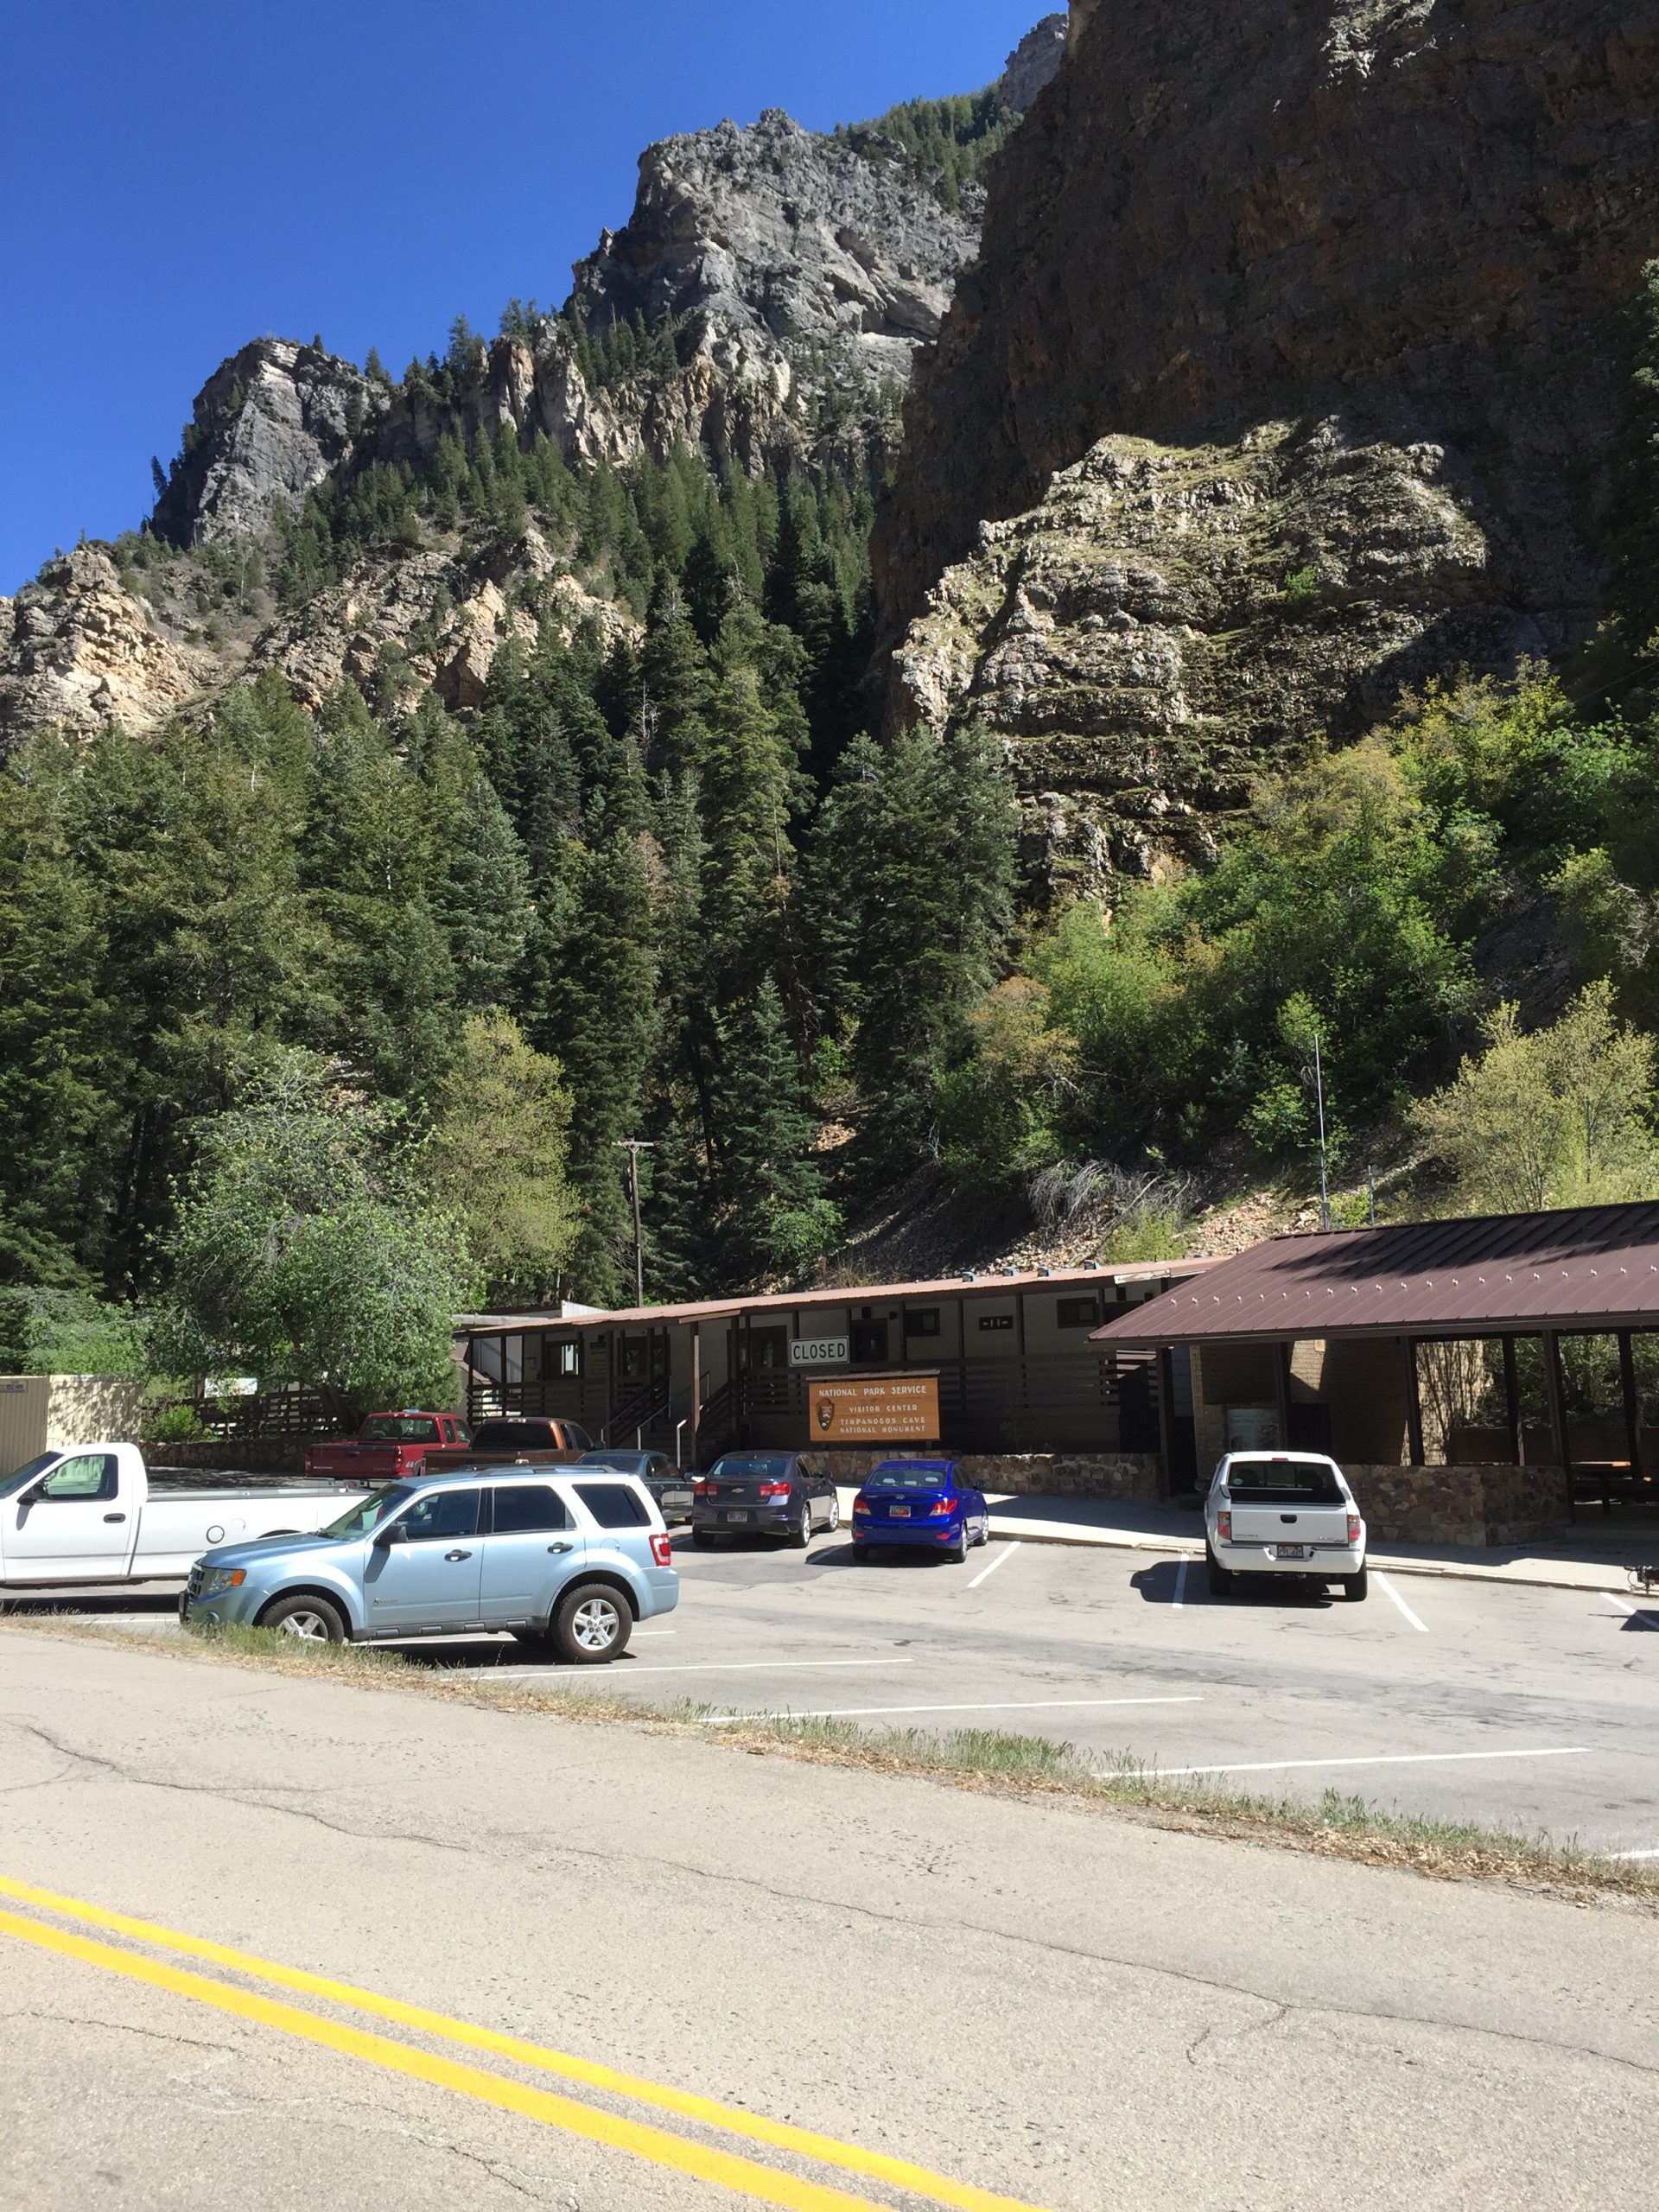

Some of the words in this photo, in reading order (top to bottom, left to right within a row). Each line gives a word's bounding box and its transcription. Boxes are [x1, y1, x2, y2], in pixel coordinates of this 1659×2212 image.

[793, 1343, 845, 1359] CLOSED
[818, 1389, 857, 1397] NATIONAL
[863, 1387, 886, 1395] PARK
[891, 1385, 927, 1395] SERVICE
[840, 1417, 897, 1426] TIMPANOGOS
